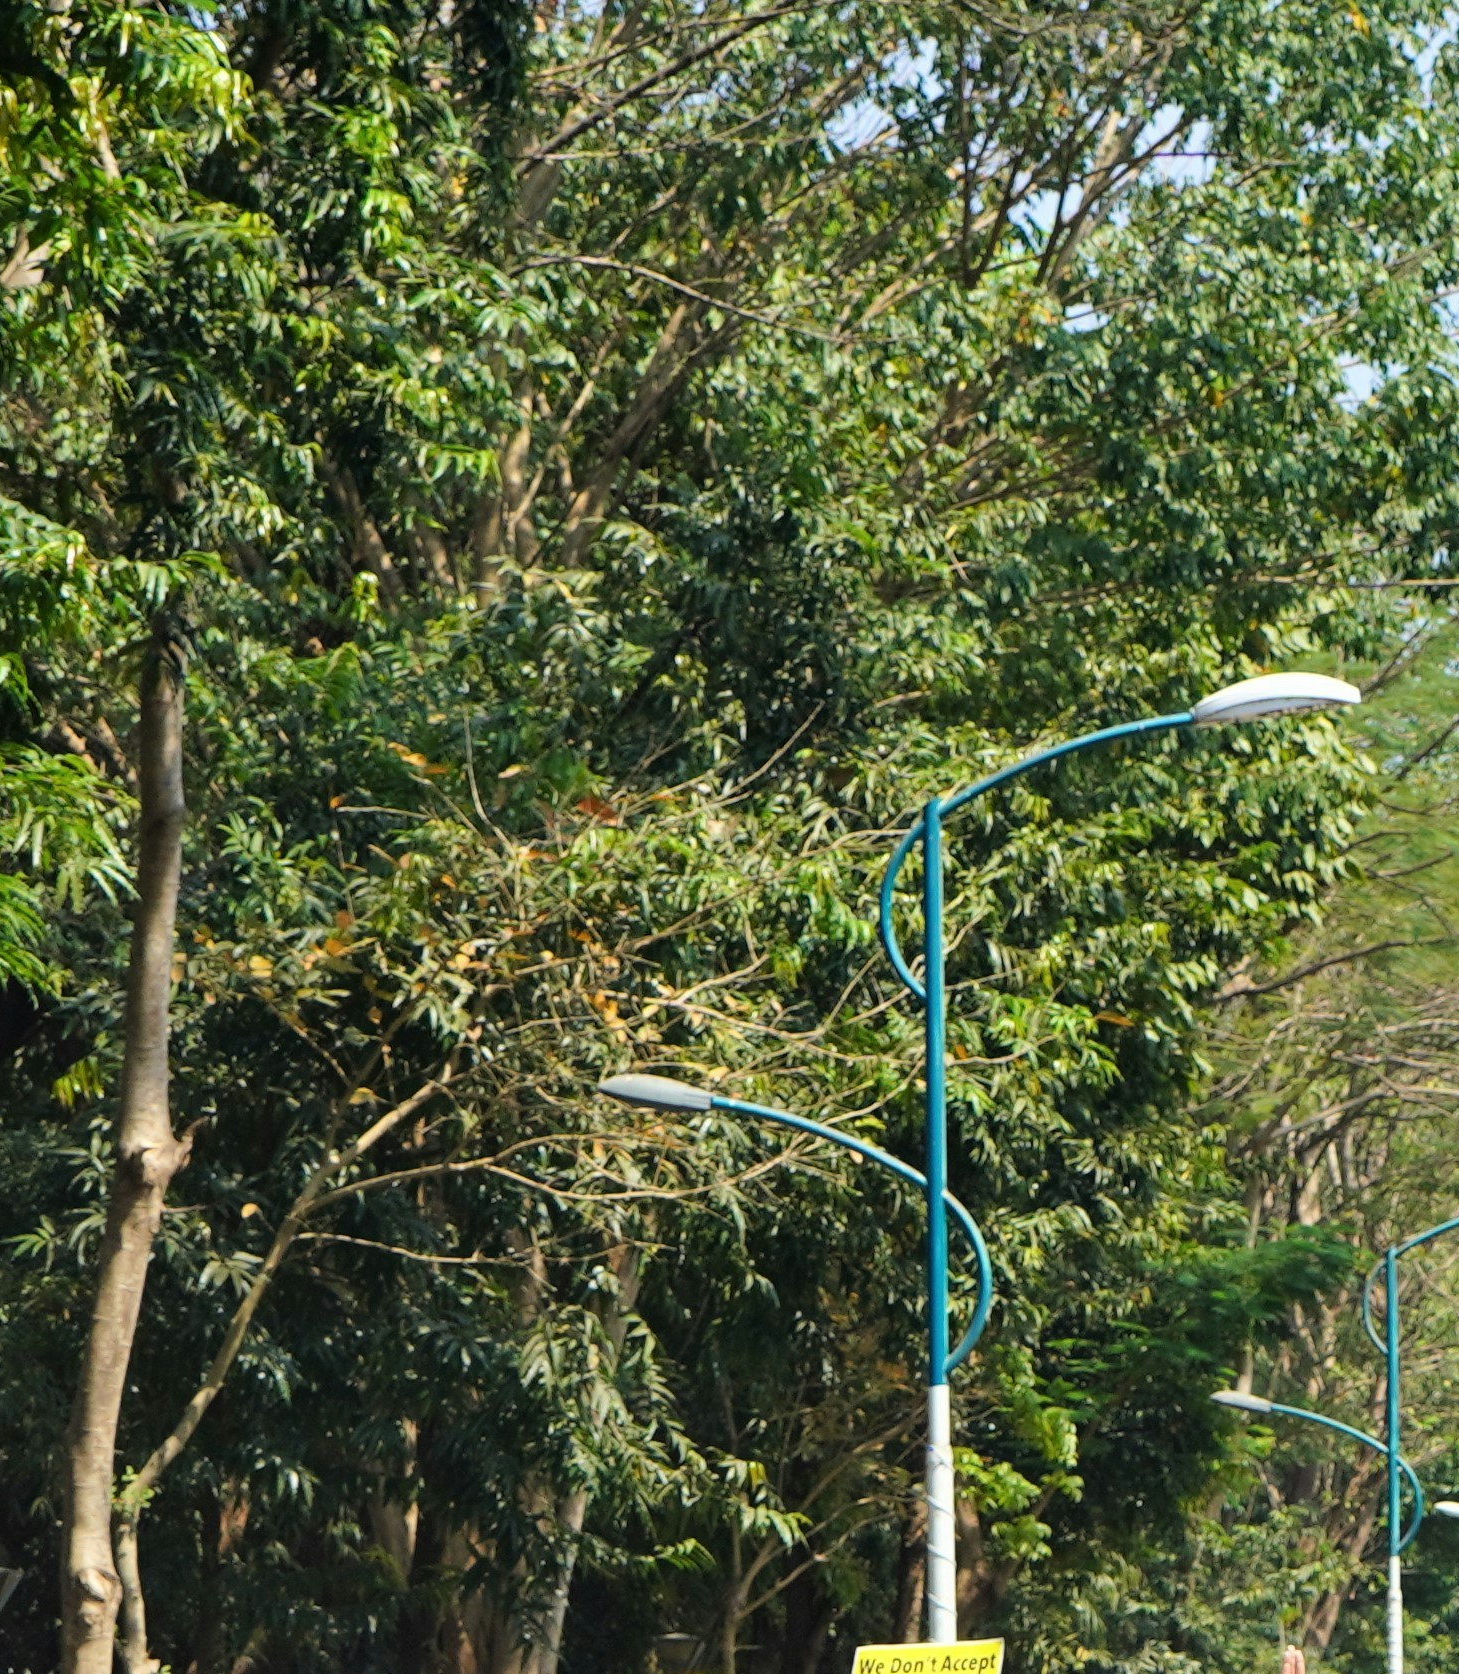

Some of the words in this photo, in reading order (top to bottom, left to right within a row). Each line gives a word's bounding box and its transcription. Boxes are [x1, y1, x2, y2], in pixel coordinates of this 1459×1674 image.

[860, 1658, 884, 1674] We
[891, 1656, 937, 1674] Don't
[942, 1653, 997, 1674] Accept
